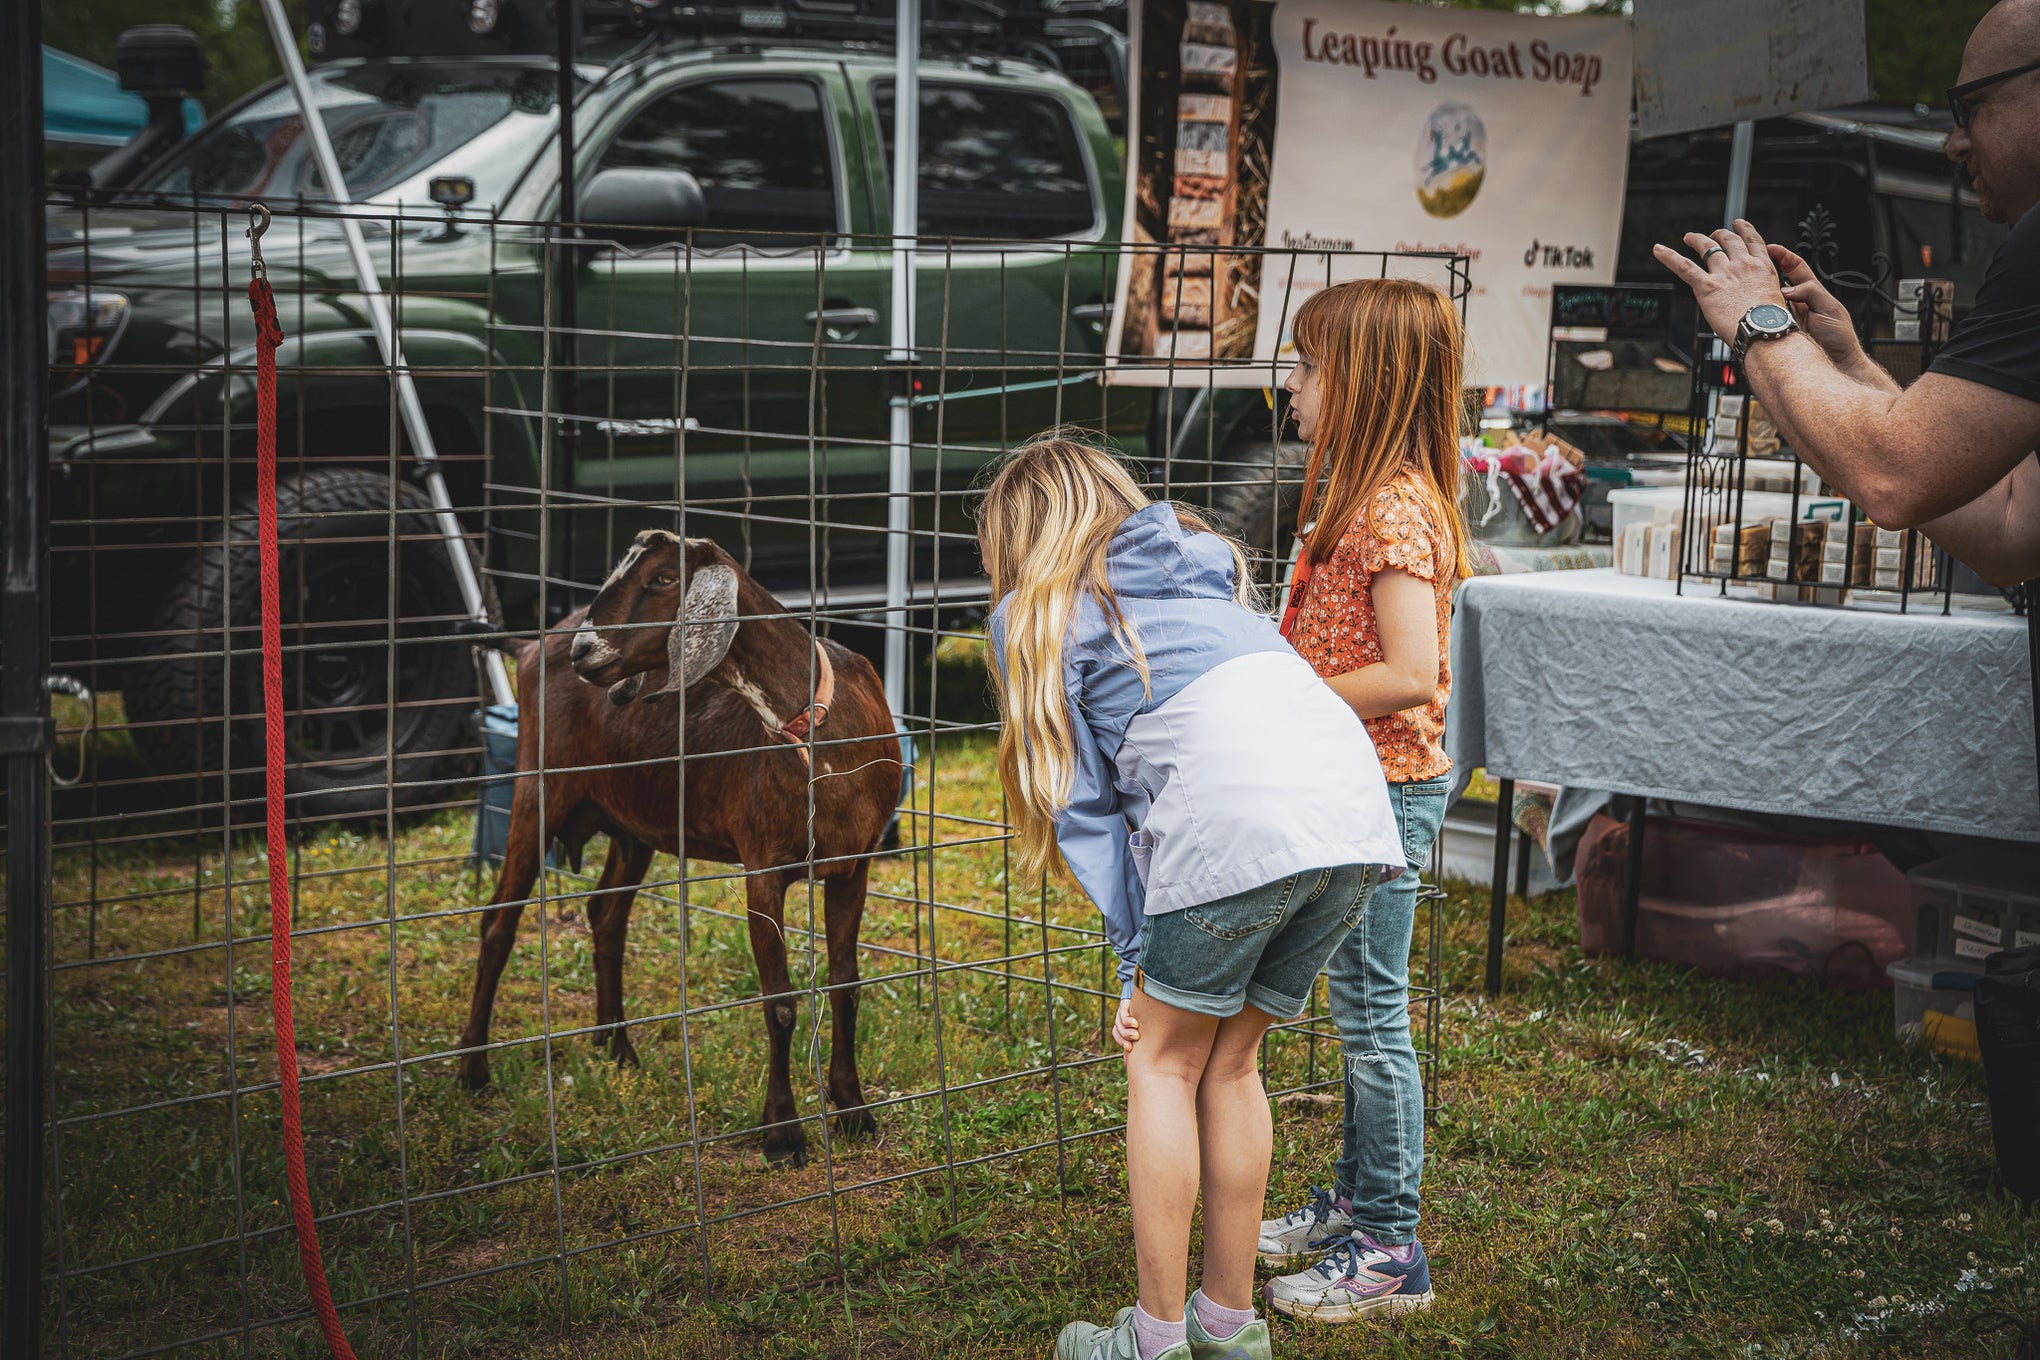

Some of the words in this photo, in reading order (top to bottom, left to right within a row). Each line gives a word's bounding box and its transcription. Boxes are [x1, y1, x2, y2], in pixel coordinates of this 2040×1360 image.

[1302, 17, 1438, 85] Leaping
[1441, 32, 1525, 80] Goat
[1530, 38, 1602, 97] Soap
[1543, 245, 1595, 271] TikTok
